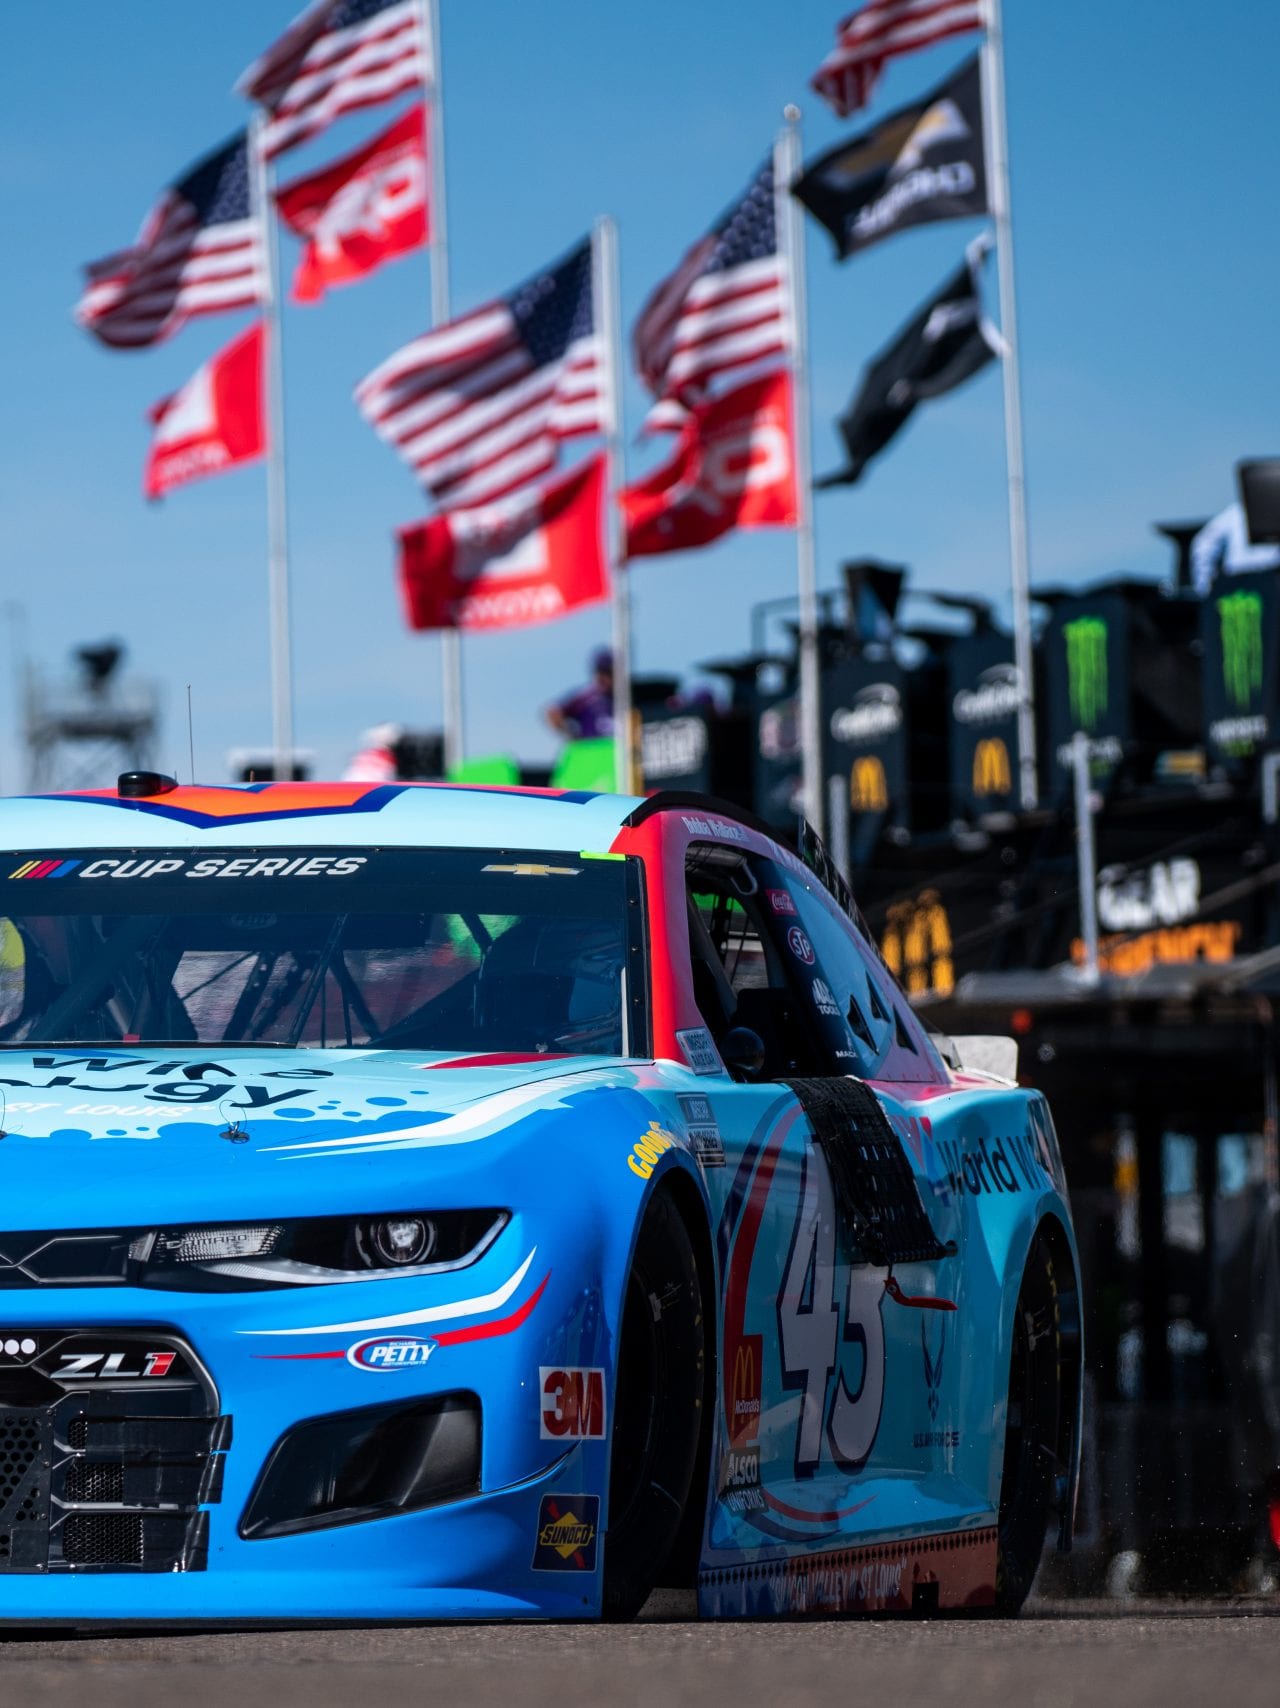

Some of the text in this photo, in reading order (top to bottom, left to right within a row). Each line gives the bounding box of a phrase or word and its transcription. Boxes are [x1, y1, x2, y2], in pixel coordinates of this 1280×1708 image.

[78, 857, 368, 878] CUP SERIES
[791, 931, 811, 960] STP
[936, 1135, 1021, 1196] World
[49, 1352, 177, 1379] ZL1
[369, 1344, 437, 1363] PETTY
[543, 1370, 603, 1436] 3M
[726, 1453, 758, 1485] ALSCO
[542, 1525, 590, 1544] SUNOCO
